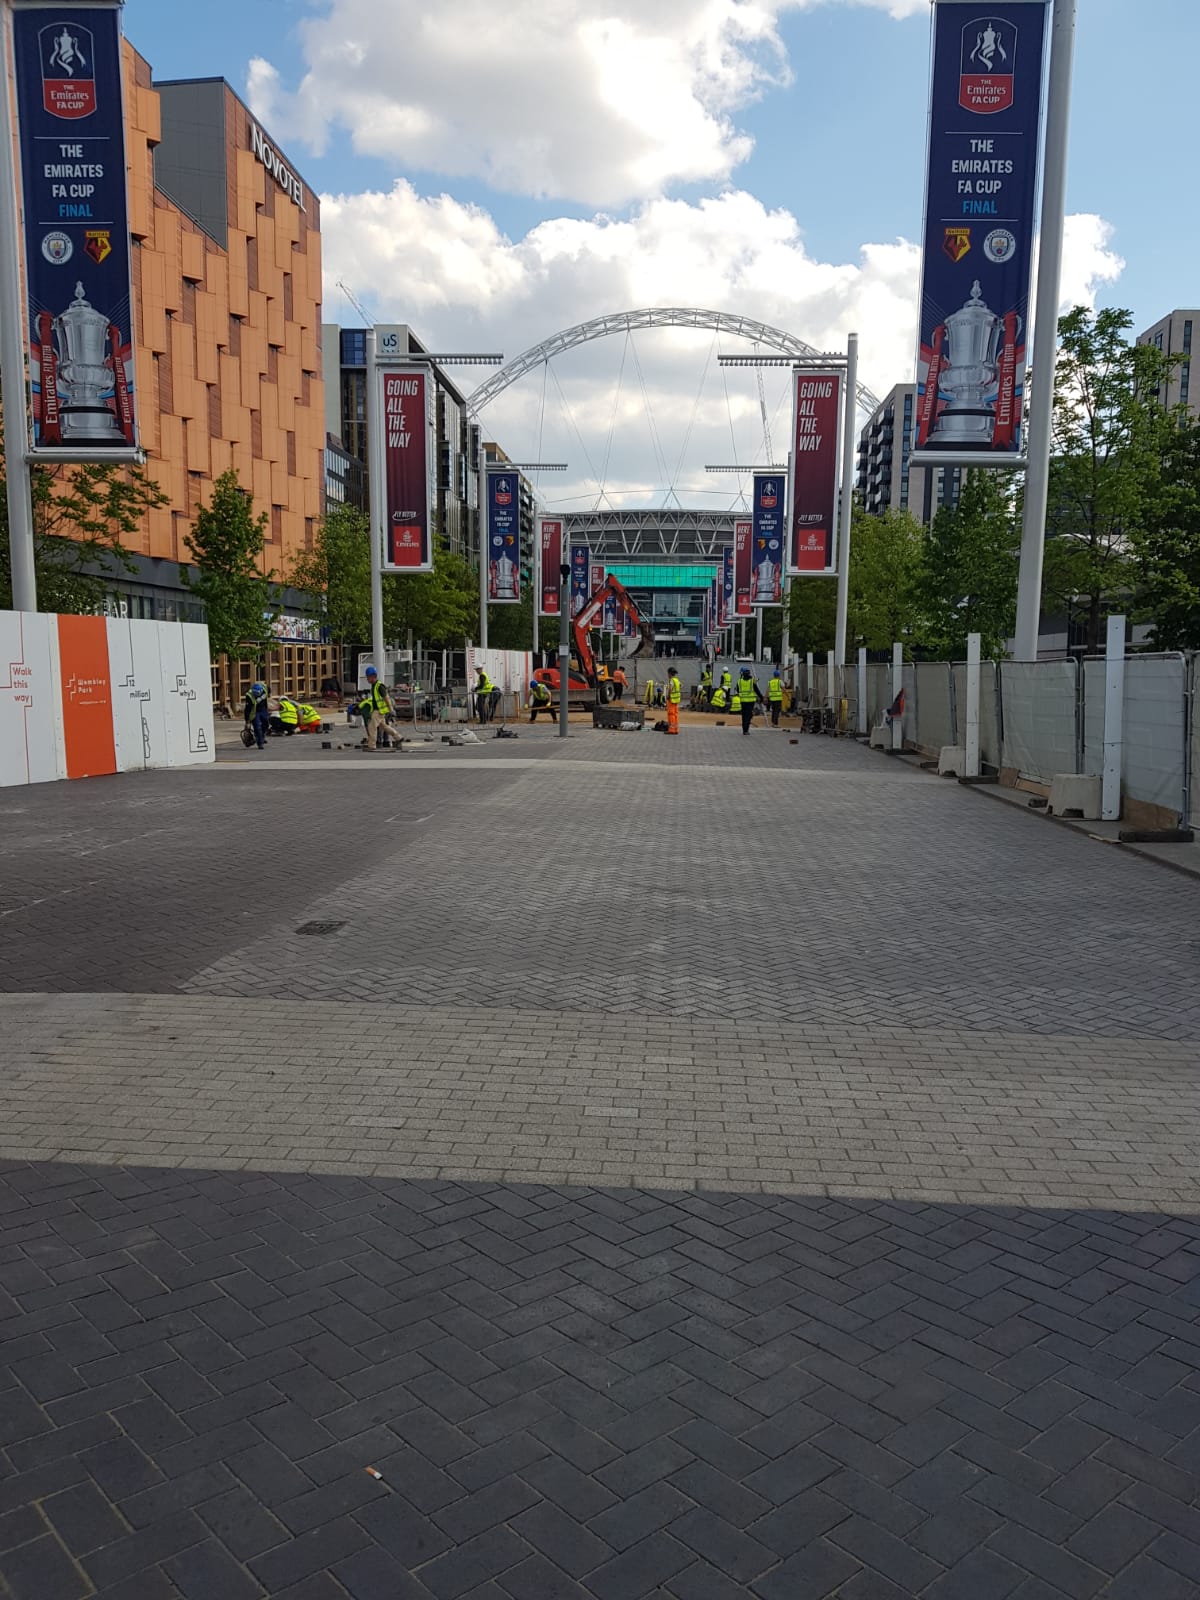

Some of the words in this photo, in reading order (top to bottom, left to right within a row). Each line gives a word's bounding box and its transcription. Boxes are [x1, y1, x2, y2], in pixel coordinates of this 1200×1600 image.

[51, 90, 89, 100] Emirates
[967, 86, 1007, 95] Emirates
[56, 101, 67, 110] FA
[68, 101, 85, 110] CUP
[971, 96, 982, 104] FA
[982, 96, 1001, 104] CUP
[59, 144, 84, 158] THE
[970, 139, 994, 153] THE
[44, 164, 104, 178] EMIRATES
[252, 122, 307, 214] NOVOTEL
[951, 160, 1013, 174] EMIRATES
[52, 185, 67, 198] FA
[70, 184, 95, 198] CUP
[957, 180, 973, 193] FA
[976, 180, 1002, 194] CUP
[59, 204, 93, 217] FINAL
[962, 200, 998, 214] FINAL
[387, 380, 419, 396] GOING
[800, 382, 833, 398] GOING
[45, 375, 58, 424] Emirates
[120, 385, 132, 423] Emirates
[386, 398, 403, 413] ALL
[922, 383, 935, 421] Emirates
[997, 376, 1013, 425] Emirates
[799, 400, 815, 416] ALL
[388, 415, 406, 431] THE
[800, 417, 818, 433] THE
[388, 432, 411, 448] WAY
[799, 435, 822, 451] WAY
[12, 667, 32, 676] Walk
[14, 680, 28, 689] this
[14, 695, 29, 703] way
[129, 690, 148, 699] million
[180, 690, 194, 698] why?
